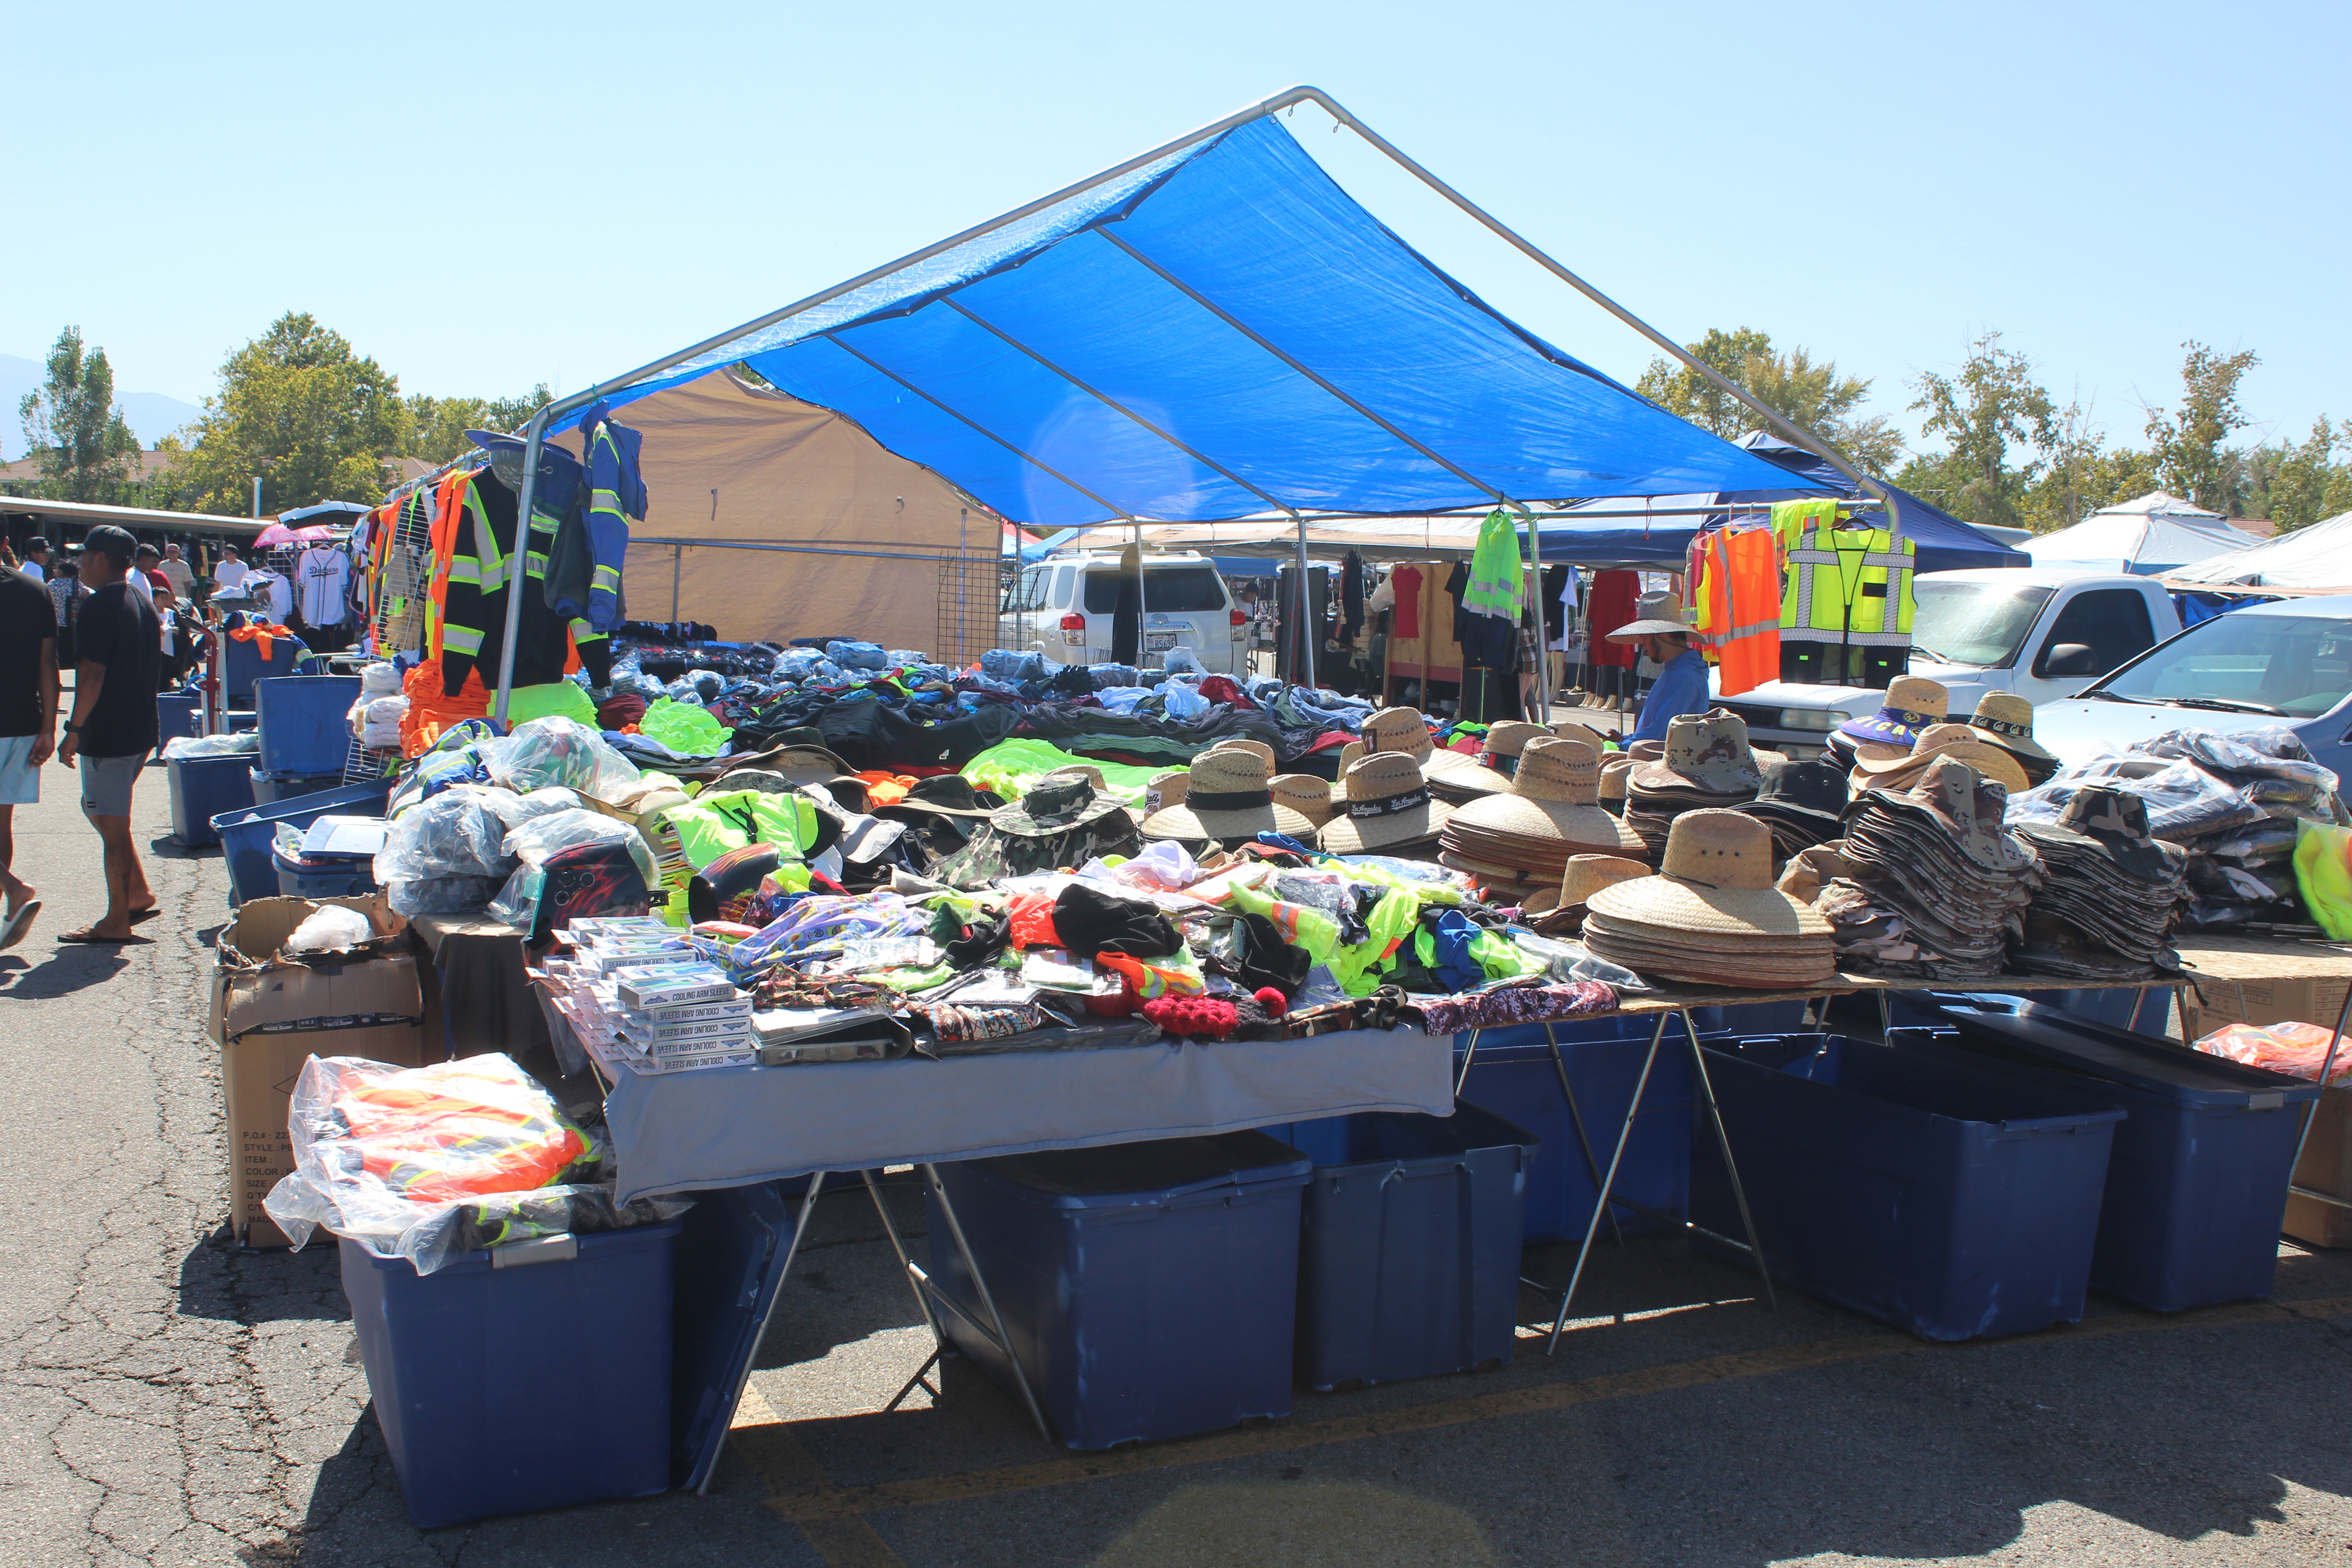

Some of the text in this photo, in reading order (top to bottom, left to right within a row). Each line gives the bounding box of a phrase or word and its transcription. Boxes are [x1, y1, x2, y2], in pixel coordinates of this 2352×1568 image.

[309, 566, 339, 575] Dodgers
[1391, 794, 1421, 807] Los Angeles
[1358, 804, 1382, 816] Angeles
[672, 987, 730, 1001] COOLING ARM SLEEVE
[659, 1007, 719, 1020] COOLING ARM SLEEVE
[658, 1024, 718, 1037] COOLING ARM SLEEVE
[657, 1041, 716, 1054] COOLING ARM SLEEVE
[664, 1056, 723, 1069] COOLING ARM SLEEVE
